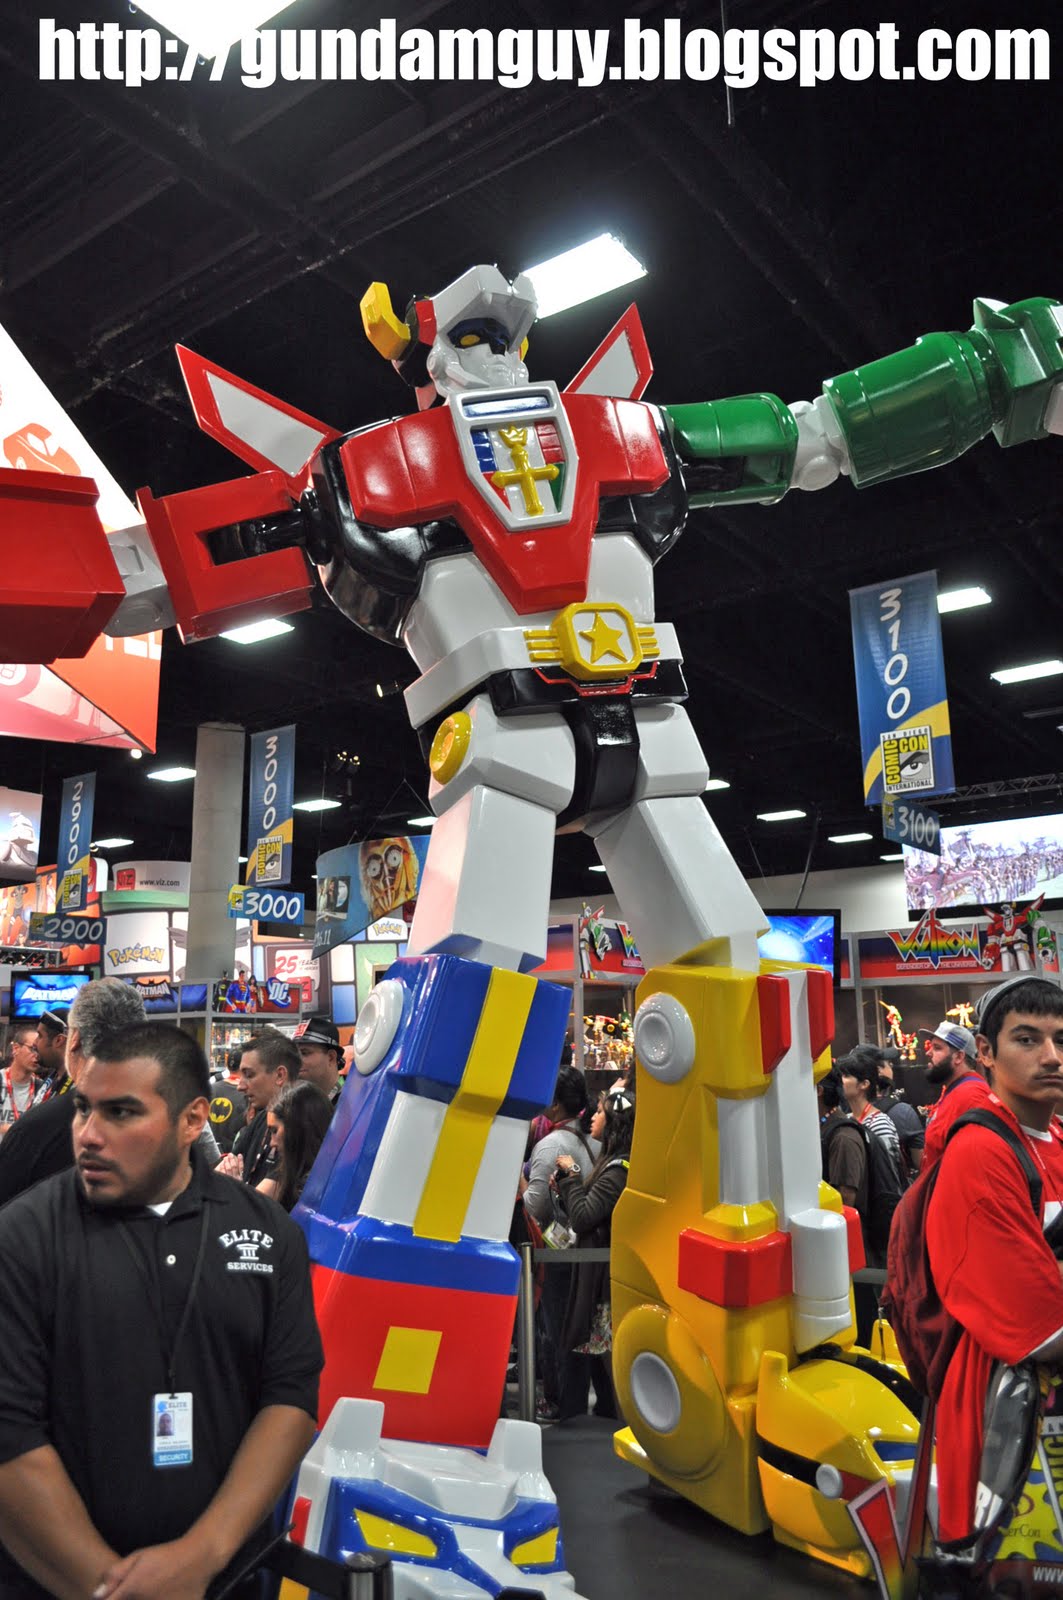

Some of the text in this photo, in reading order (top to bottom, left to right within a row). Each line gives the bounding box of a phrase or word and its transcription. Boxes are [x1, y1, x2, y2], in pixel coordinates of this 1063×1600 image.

[879, 588, 911, 720] 3100
[903, 728, 928, 736] DIEGO
[899, 735, 928, 753] CON
[884, 740, 900, 784] COMIC
[264, 736, 278, 828] 3000
[886, 779, 932, 791] INTERNATIONAL
[68, 782, 83, 864] 2900
[898, 805, 937, 847] 3100
[266, 842, 281, 854] CON
[257, 844, 267, 876] COMIC
[139, 877, 181, 887] www.viz.com
[245, 892, 300, 920] 3000
[44, 918, 104, 940] 2900
[274, 955, 298, 974] 25
[268, 982, 289, 1000] DC
[219, 1229, 273, 1248] ELITE
[227, 1261, 273, 1273] SERVICES
